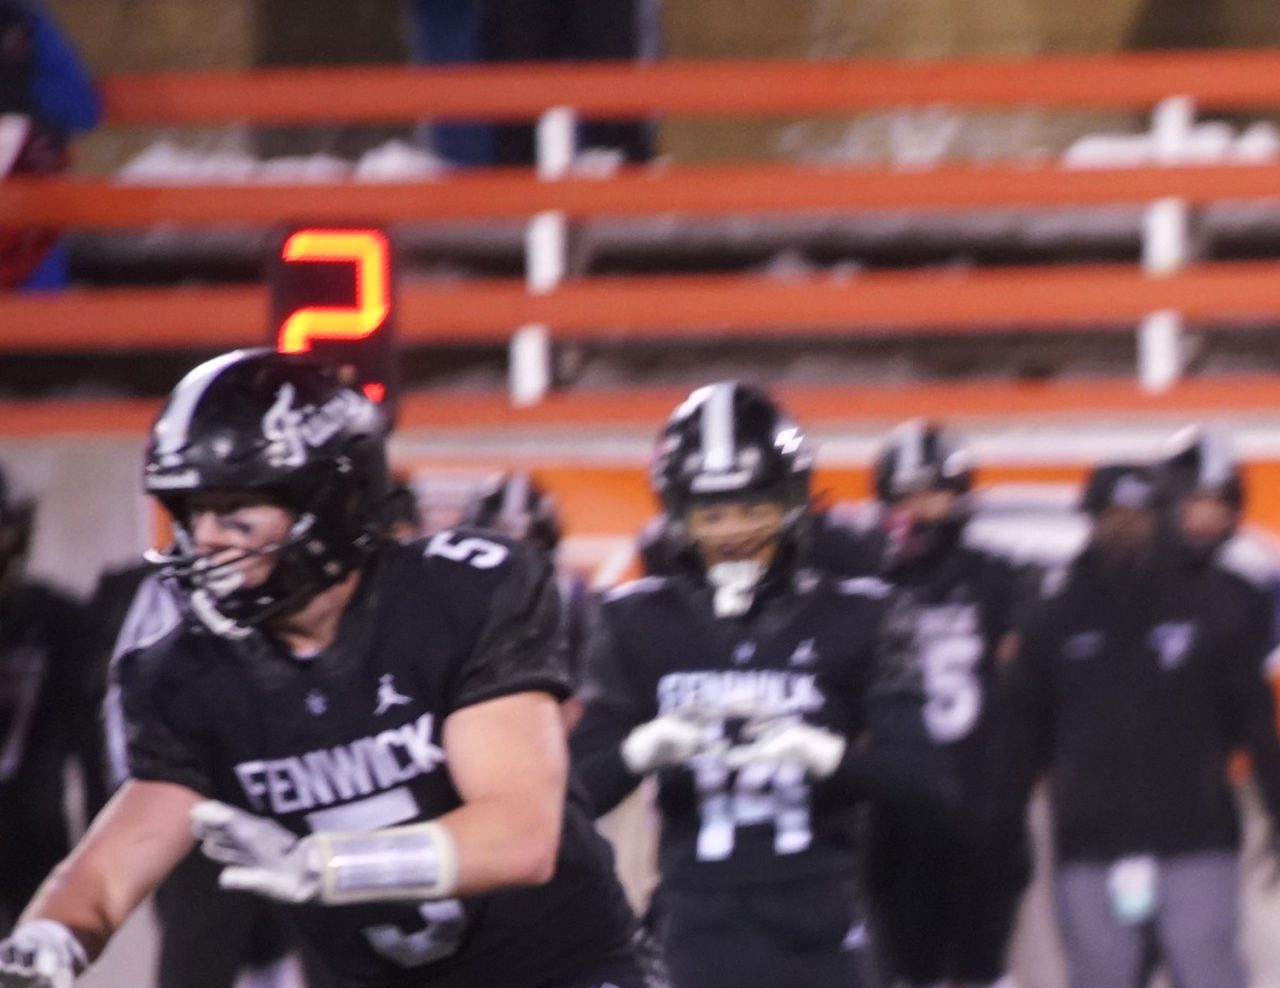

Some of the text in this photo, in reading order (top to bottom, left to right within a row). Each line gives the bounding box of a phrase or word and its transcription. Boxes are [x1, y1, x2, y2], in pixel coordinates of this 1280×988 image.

[278, 228, 391, 404] 2
[422, 530, 510, 570] 5
[234, 712, 446, 814] FENWICK
